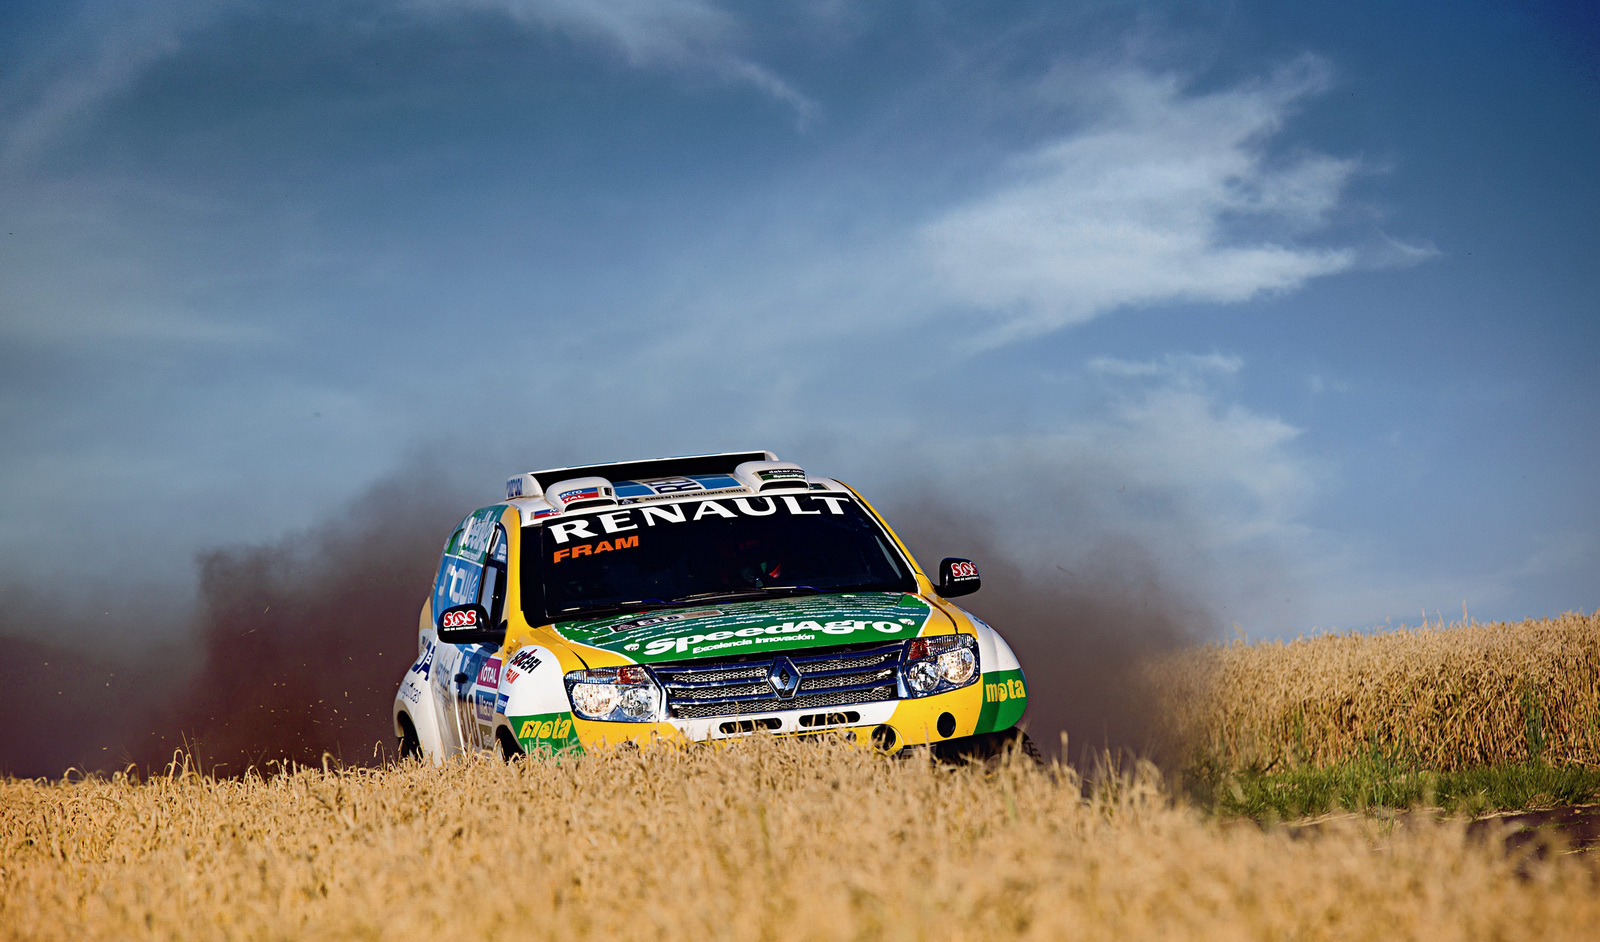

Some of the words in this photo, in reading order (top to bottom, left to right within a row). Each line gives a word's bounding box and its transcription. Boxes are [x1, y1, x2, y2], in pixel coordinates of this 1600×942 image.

[547, 495, 850, 544] RENAULT
[553, 535, 639, 564] FRAM
[643, 619, 902, 655] SpeedAgro
[693, 639, 752, 654] Excelencia
[755, 633, 815, 644] Innovación
[481, 665, 497, 684] TOTAL
[985, 678, 1026, 703] mota
[518, 718, 572, 739] mota
